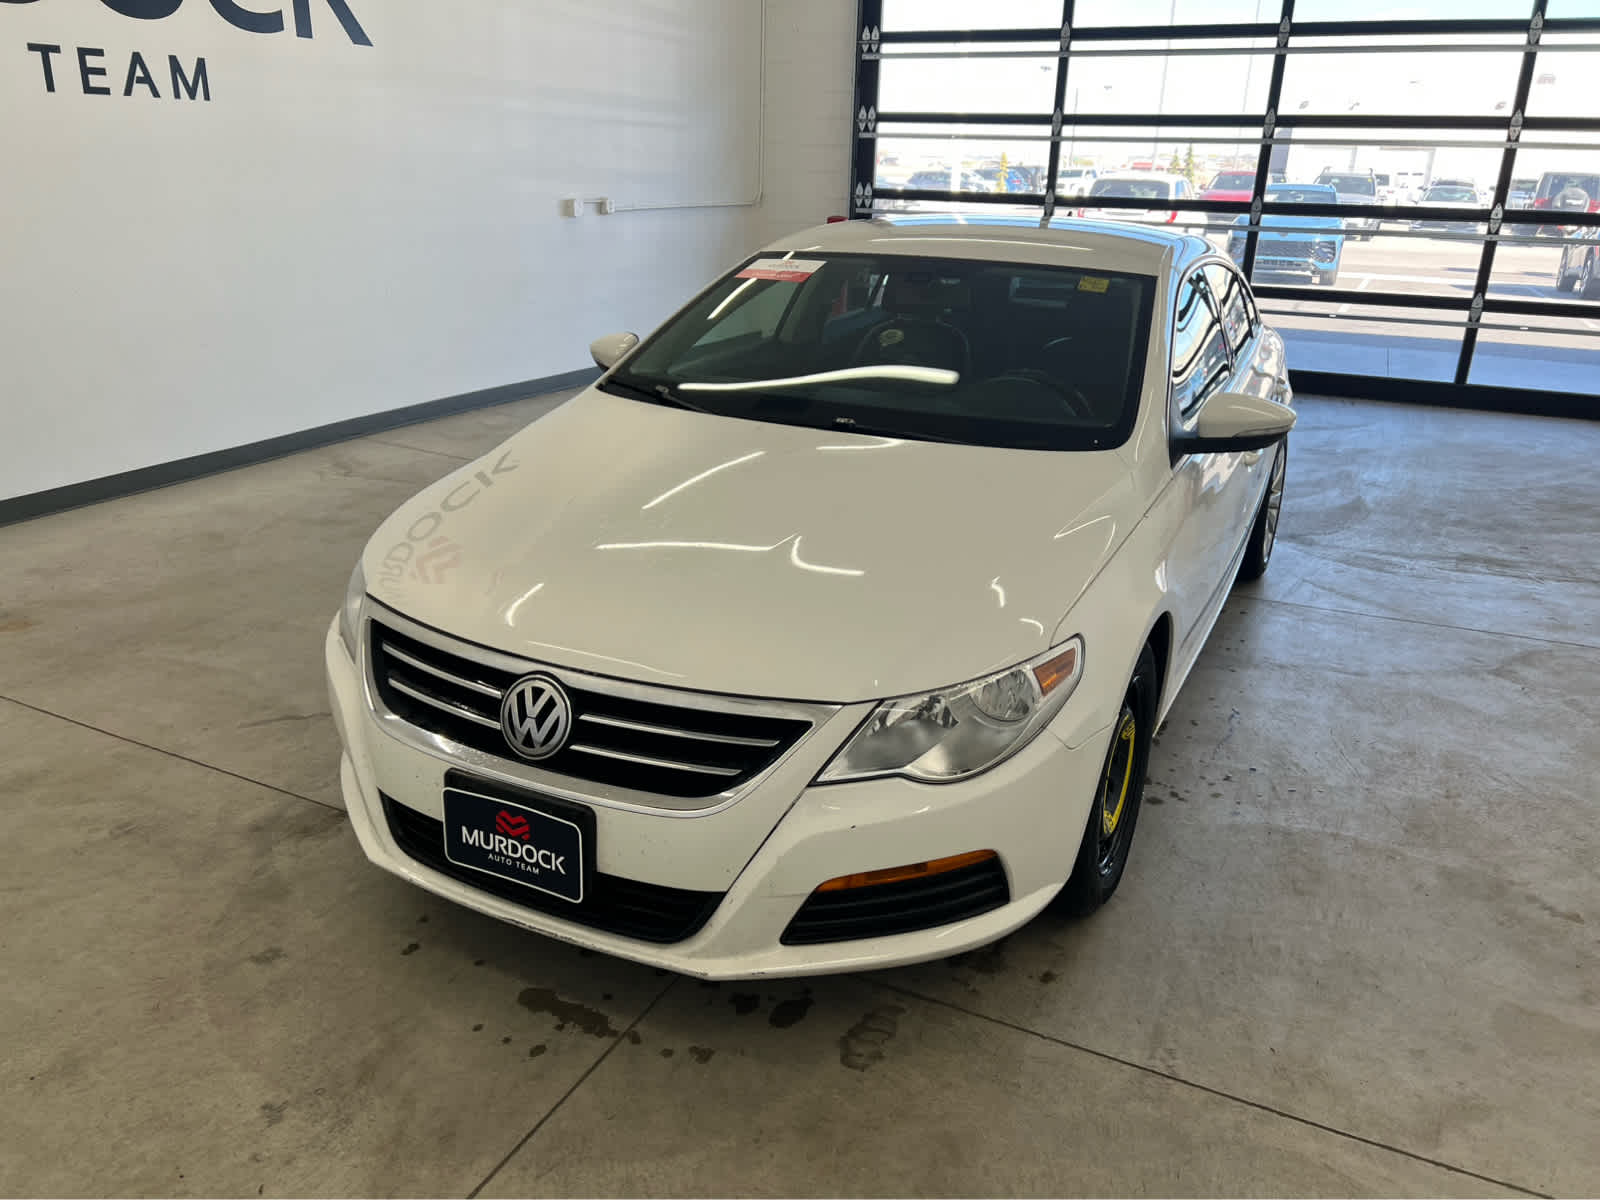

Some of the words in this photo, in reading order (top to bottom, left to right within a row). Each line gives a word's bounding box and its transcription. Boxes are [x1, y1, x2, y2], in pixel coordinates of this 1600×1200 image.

[27, 43, 211, 101] TEAM
[462, 826, 565, 875] MURDOCK
[488, 853, 511, 865] AUTO
[516, 861, 539, 874] TEAM
